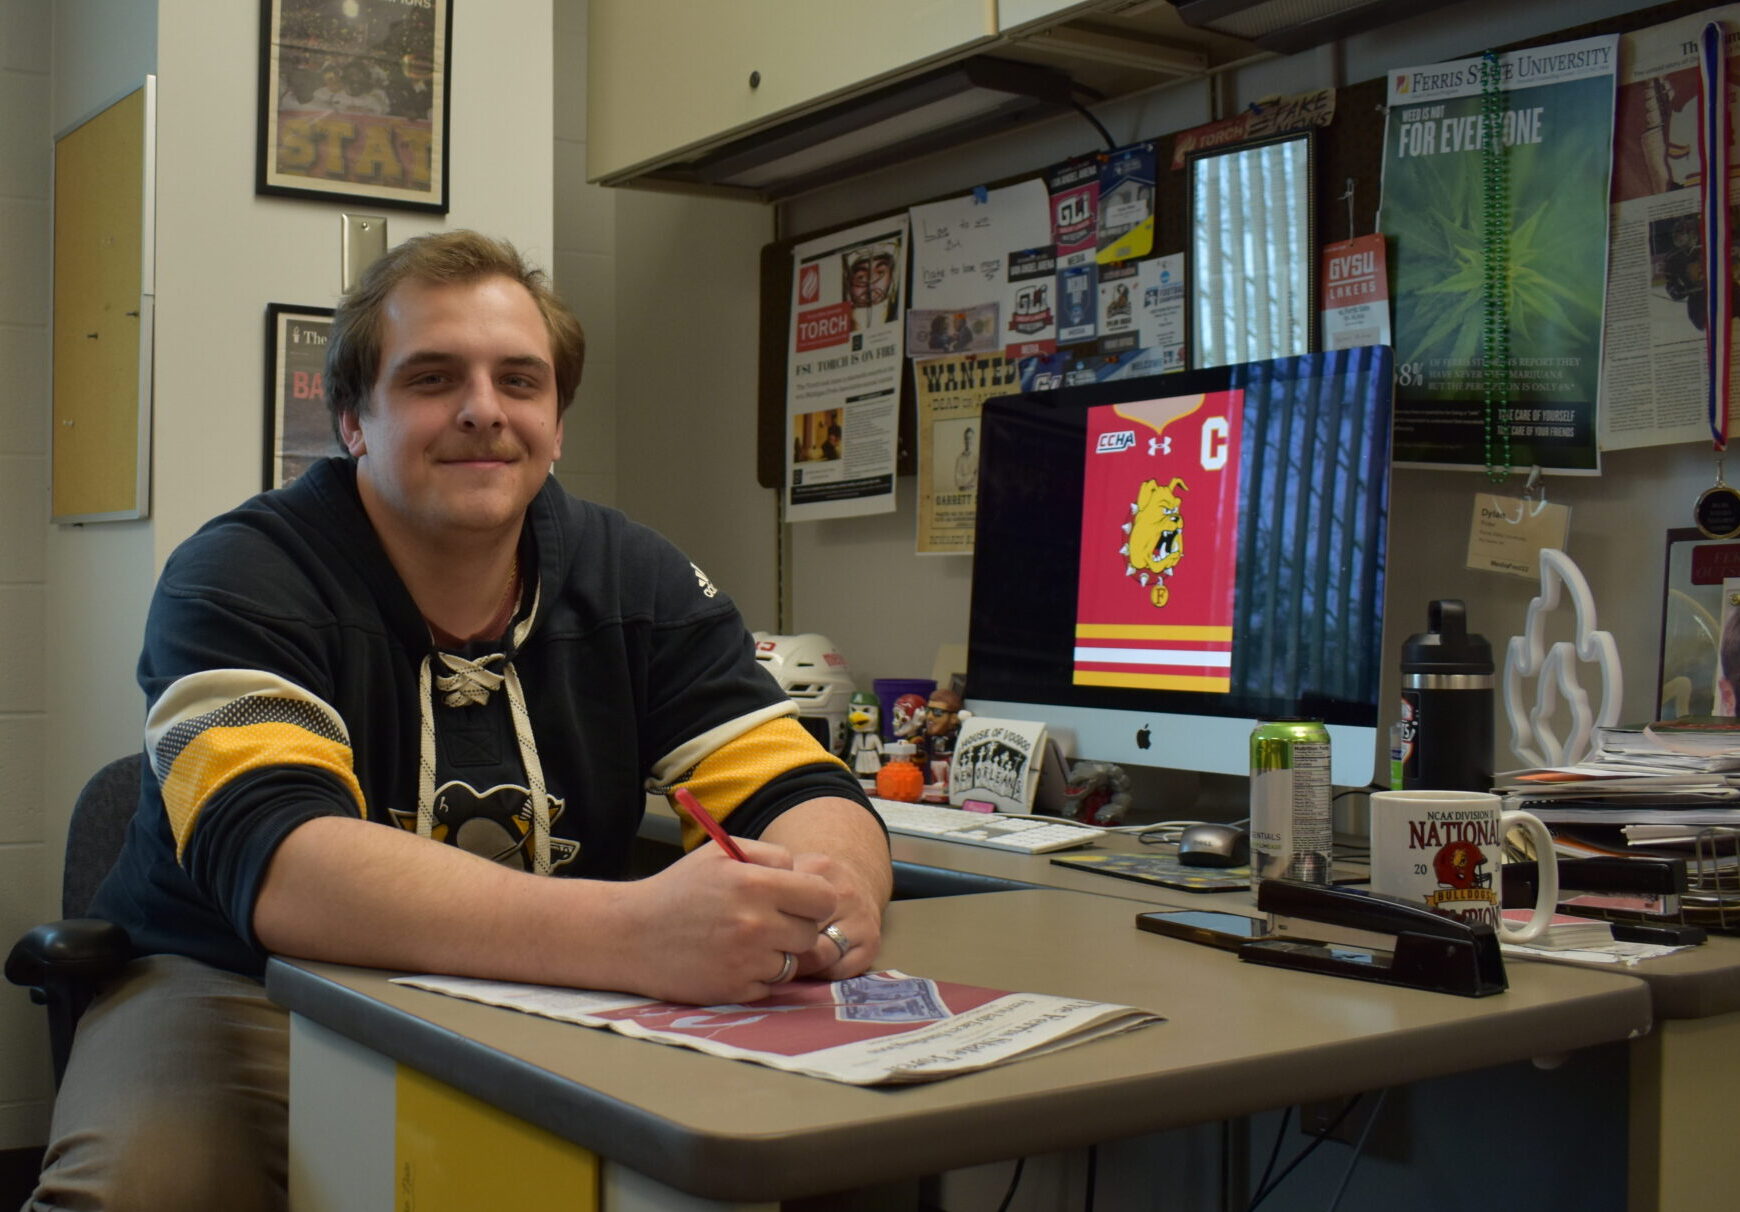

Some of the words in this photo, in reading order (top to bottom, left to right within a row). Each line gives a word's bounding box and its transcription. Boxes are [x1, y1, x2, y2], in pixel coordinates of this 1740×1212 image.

[1411, 69, 1463, 93] FERRIS
[1518, 46, 1612, 78] UNIVERSITY
[1402, 108, 1421, 123] WEED
[1421, 107, 1430, 120] IS
[1431, 105, 1445, 119] NOT
[1398, 121, 1437, 158] FOR
[1329, 250, 1375, 281] GVSU
[1329, 281, 1377, 300] LAKERS
[799, 315, 848, 340] TORCH
[303, 330, 328, 345] The
[817, 356, 849, 372] TORCH
[923, 357, 1018, 393] WANTED
[1099, 433, 1135, 448] CCHA
[1201, 416, 1228, 471] C
[991, 728, 1004, 738] OF
[1427, 811, 1453, 820] NCAA
[1455, 810, 1489, 820] DIVISION
[1414, 864, 1427, 874] 20
[1439, 890, 1490, 901] BULLDOGS
